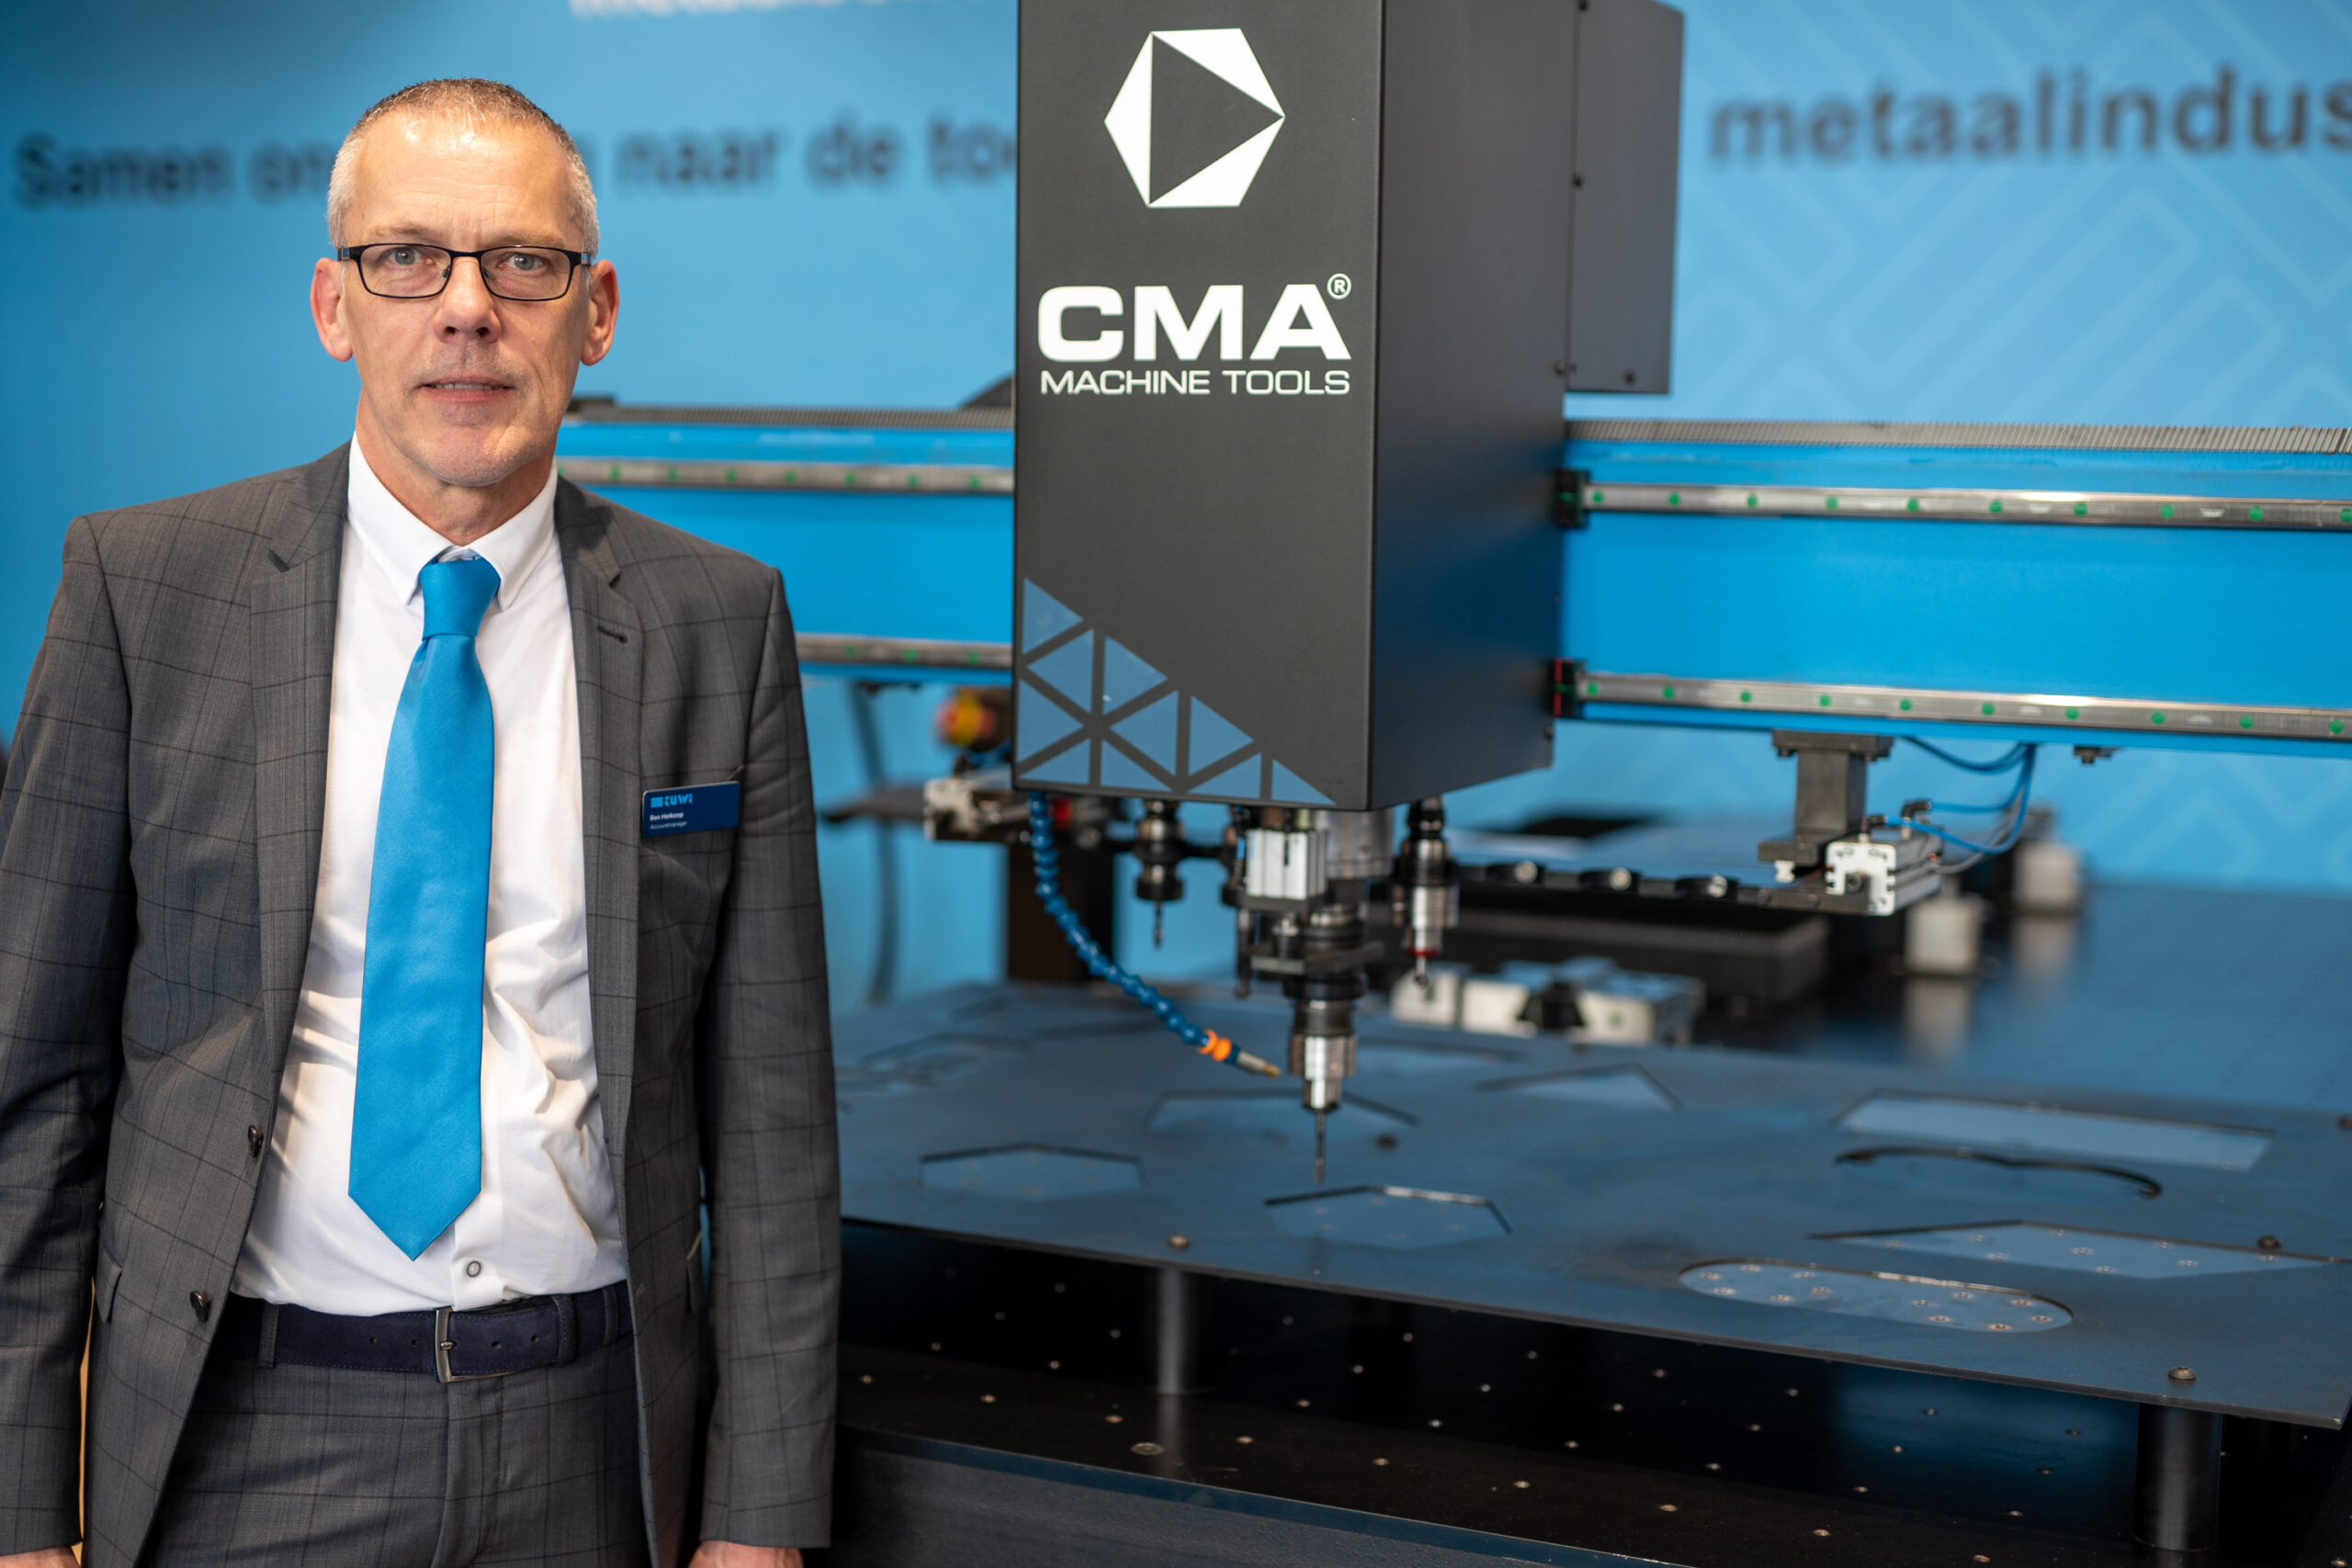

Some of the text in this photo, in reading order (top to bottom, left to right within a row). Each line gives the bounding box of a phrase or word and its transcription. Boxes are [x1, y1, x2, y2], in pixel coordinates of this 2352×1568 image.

[617, 130, 781, 191] naar
[810, 108, 905, 187] de
[925, 108, 1017, 187] to
[1041, 370, 1351, 395] MACHINE TOOLS
